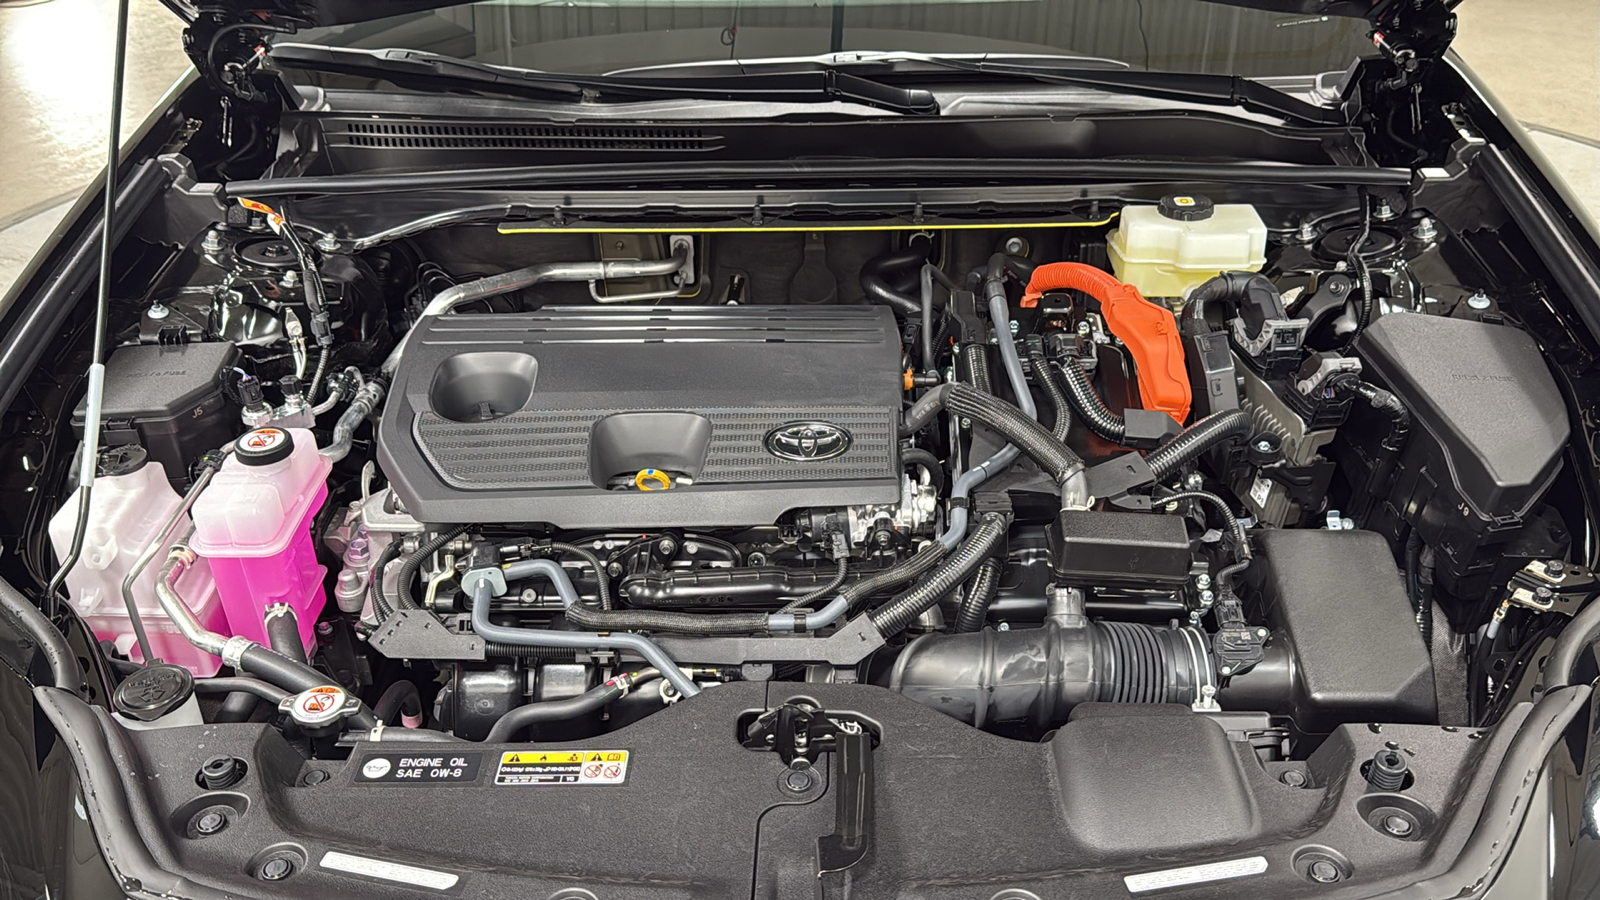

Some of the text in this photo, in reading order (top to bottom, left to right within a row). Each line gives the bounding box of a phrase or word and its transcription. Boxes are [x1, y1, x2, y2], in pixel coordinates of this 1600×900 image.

[192, 406, 204, 419] J5
[399, 757, 469, 768] ENGINE OIL
[395, 768, 463, 779] SAE 0W-8
